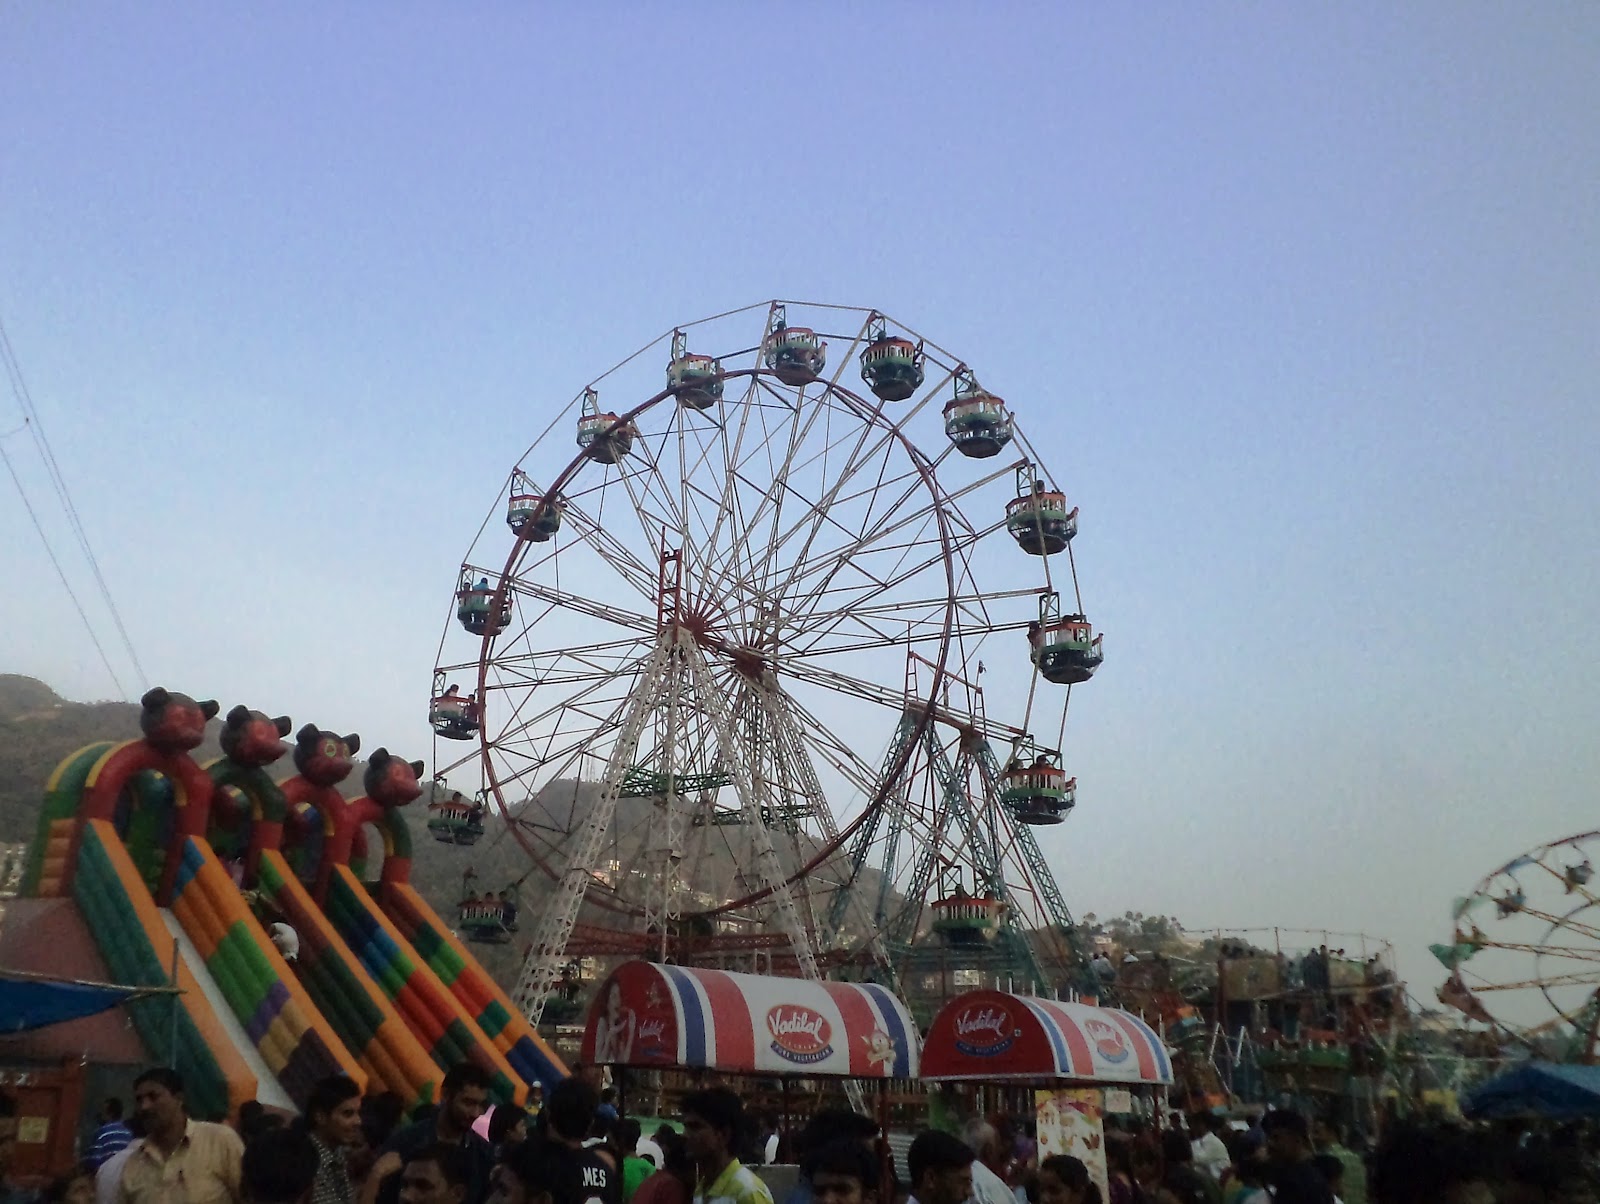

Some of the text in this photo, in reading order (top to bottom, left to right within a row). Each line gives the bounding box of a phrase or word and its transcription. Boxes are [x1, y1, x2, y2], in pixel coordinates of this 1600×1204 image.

[768, 1007, 824, 1044] Vadilal
[956, 1008, 1006, 1037] Vadilal
[582, 1166, 607, 1188] MES
